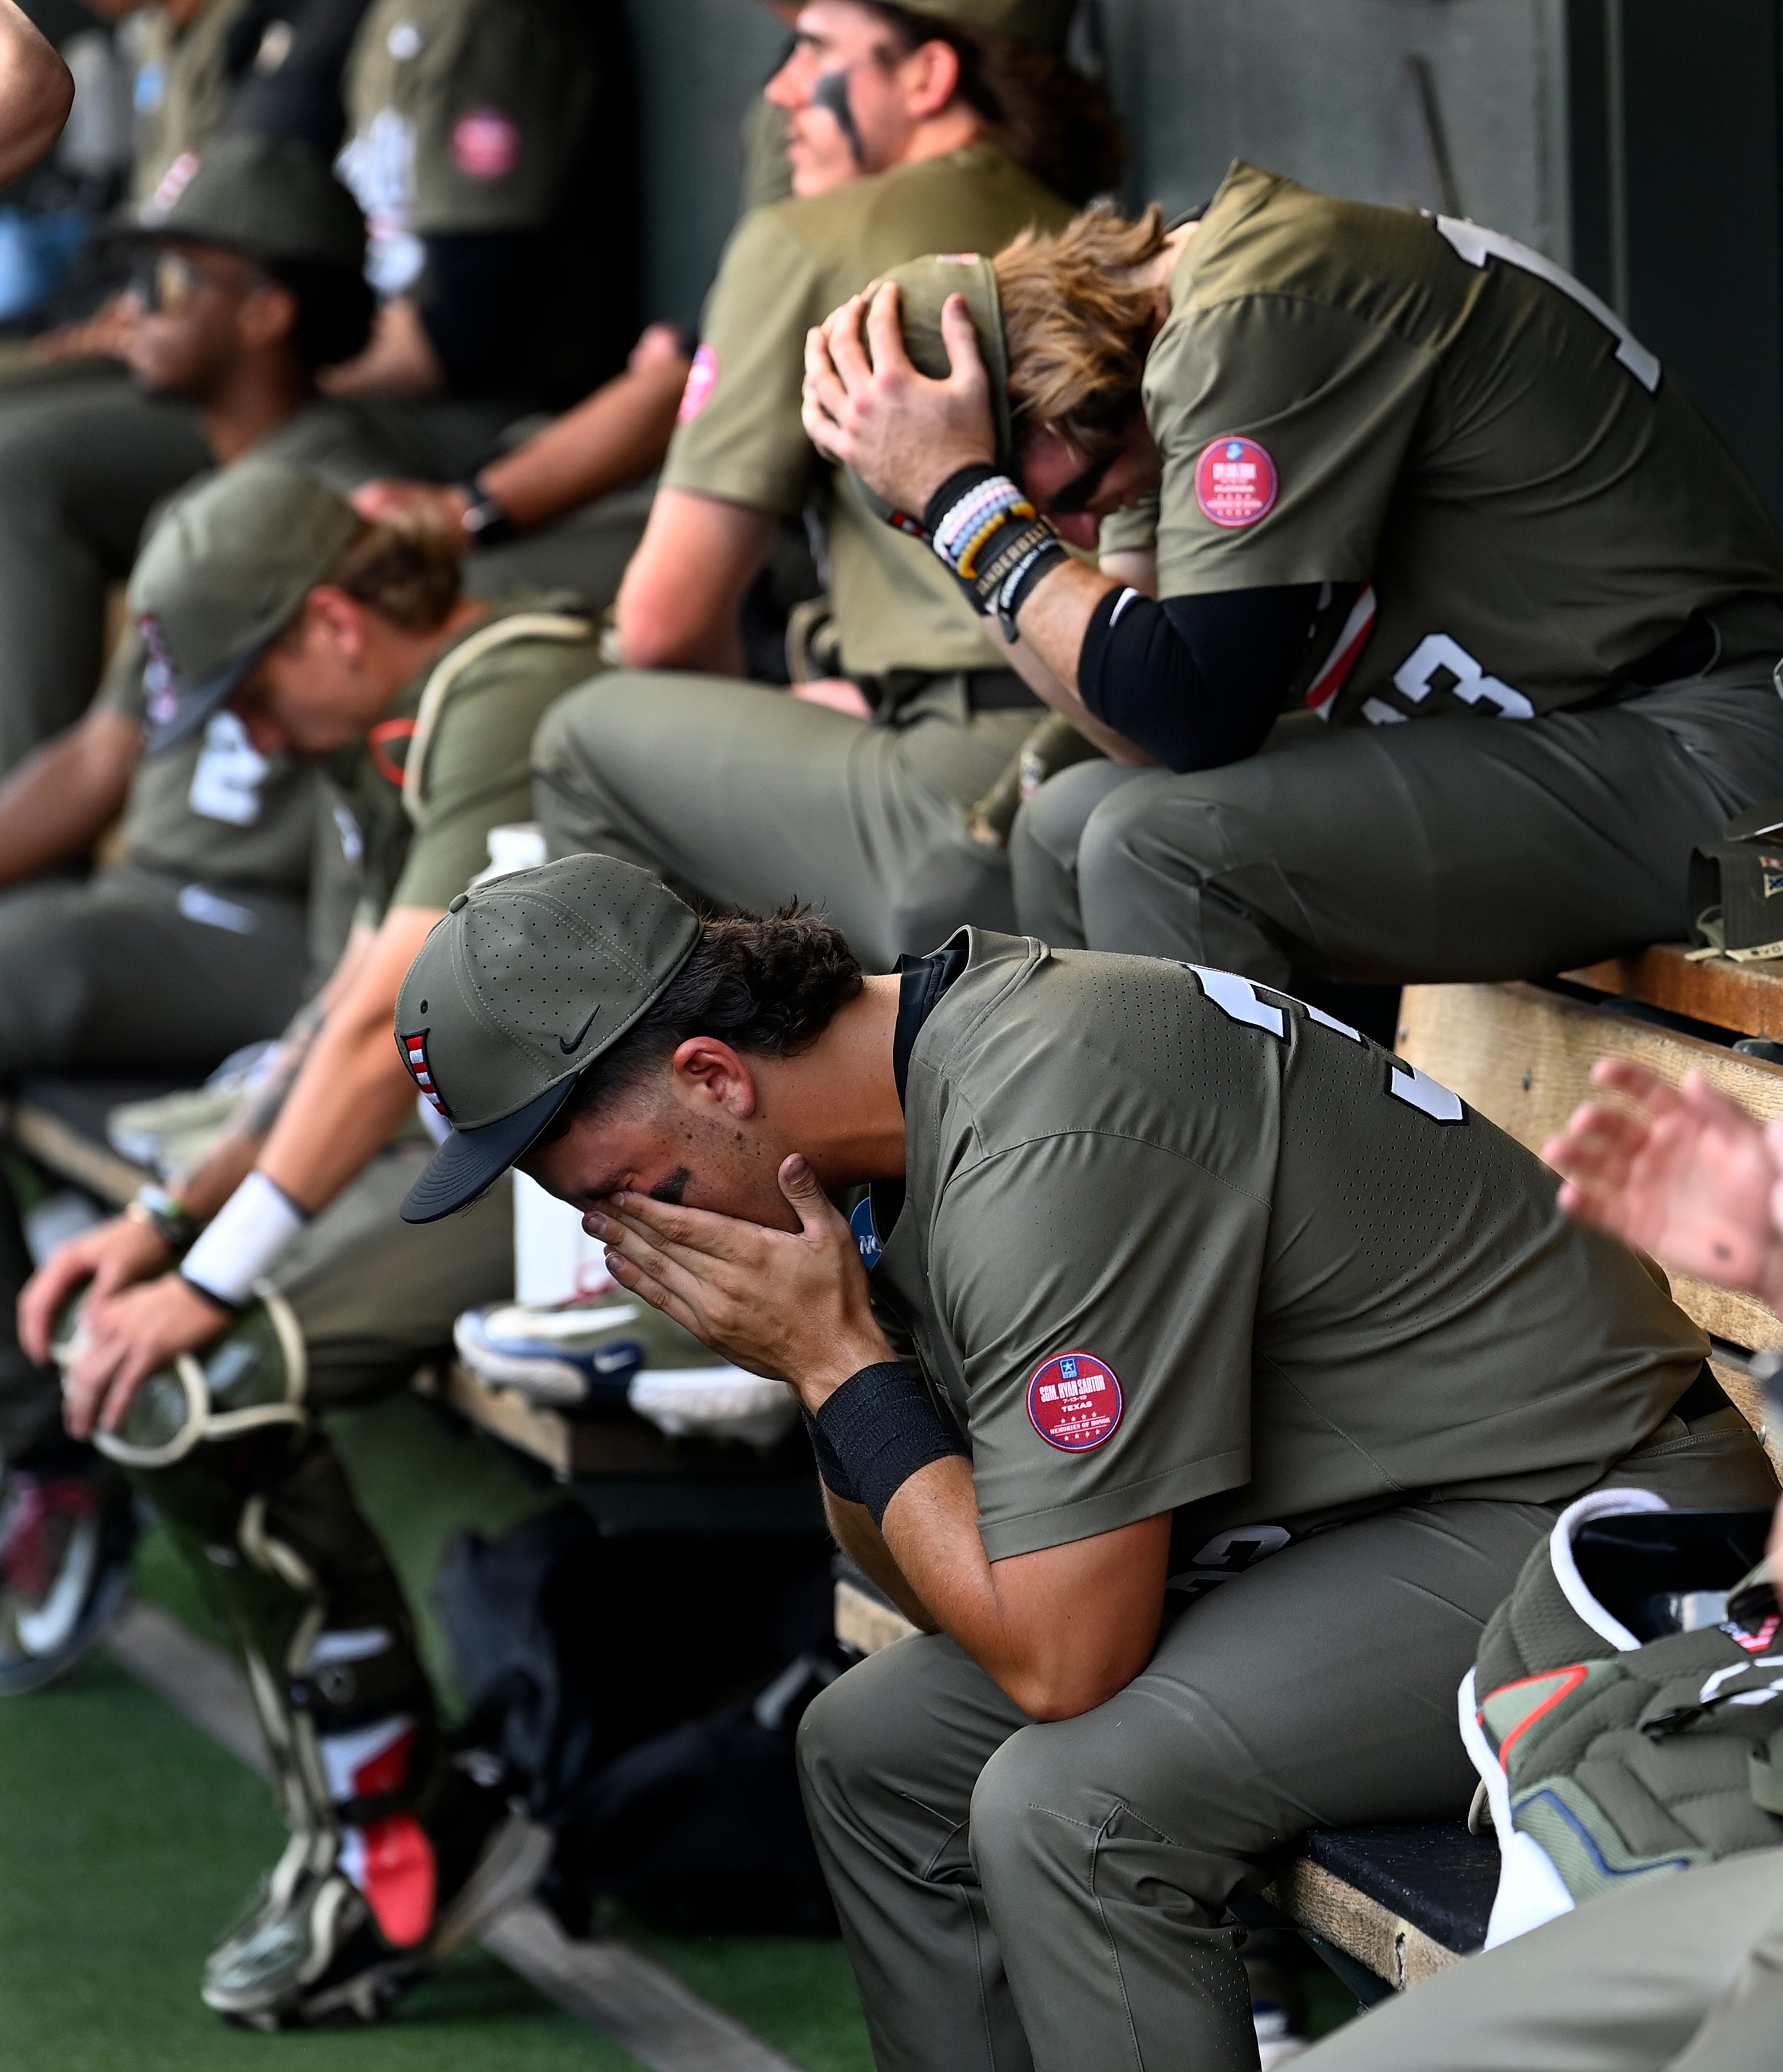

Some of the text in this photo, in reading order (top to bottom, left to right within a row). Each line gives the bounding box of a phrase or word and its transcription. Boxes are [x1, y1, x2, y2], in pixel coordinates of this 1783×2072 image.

[1058, 1380, 1078, 1399] RYAN
[1061, 1401, 1092, 1413] TEXAS
[1050, 1423, 1081, 1435] MEMORIES
[1091, 1417, 1111, 1426] HONOR
